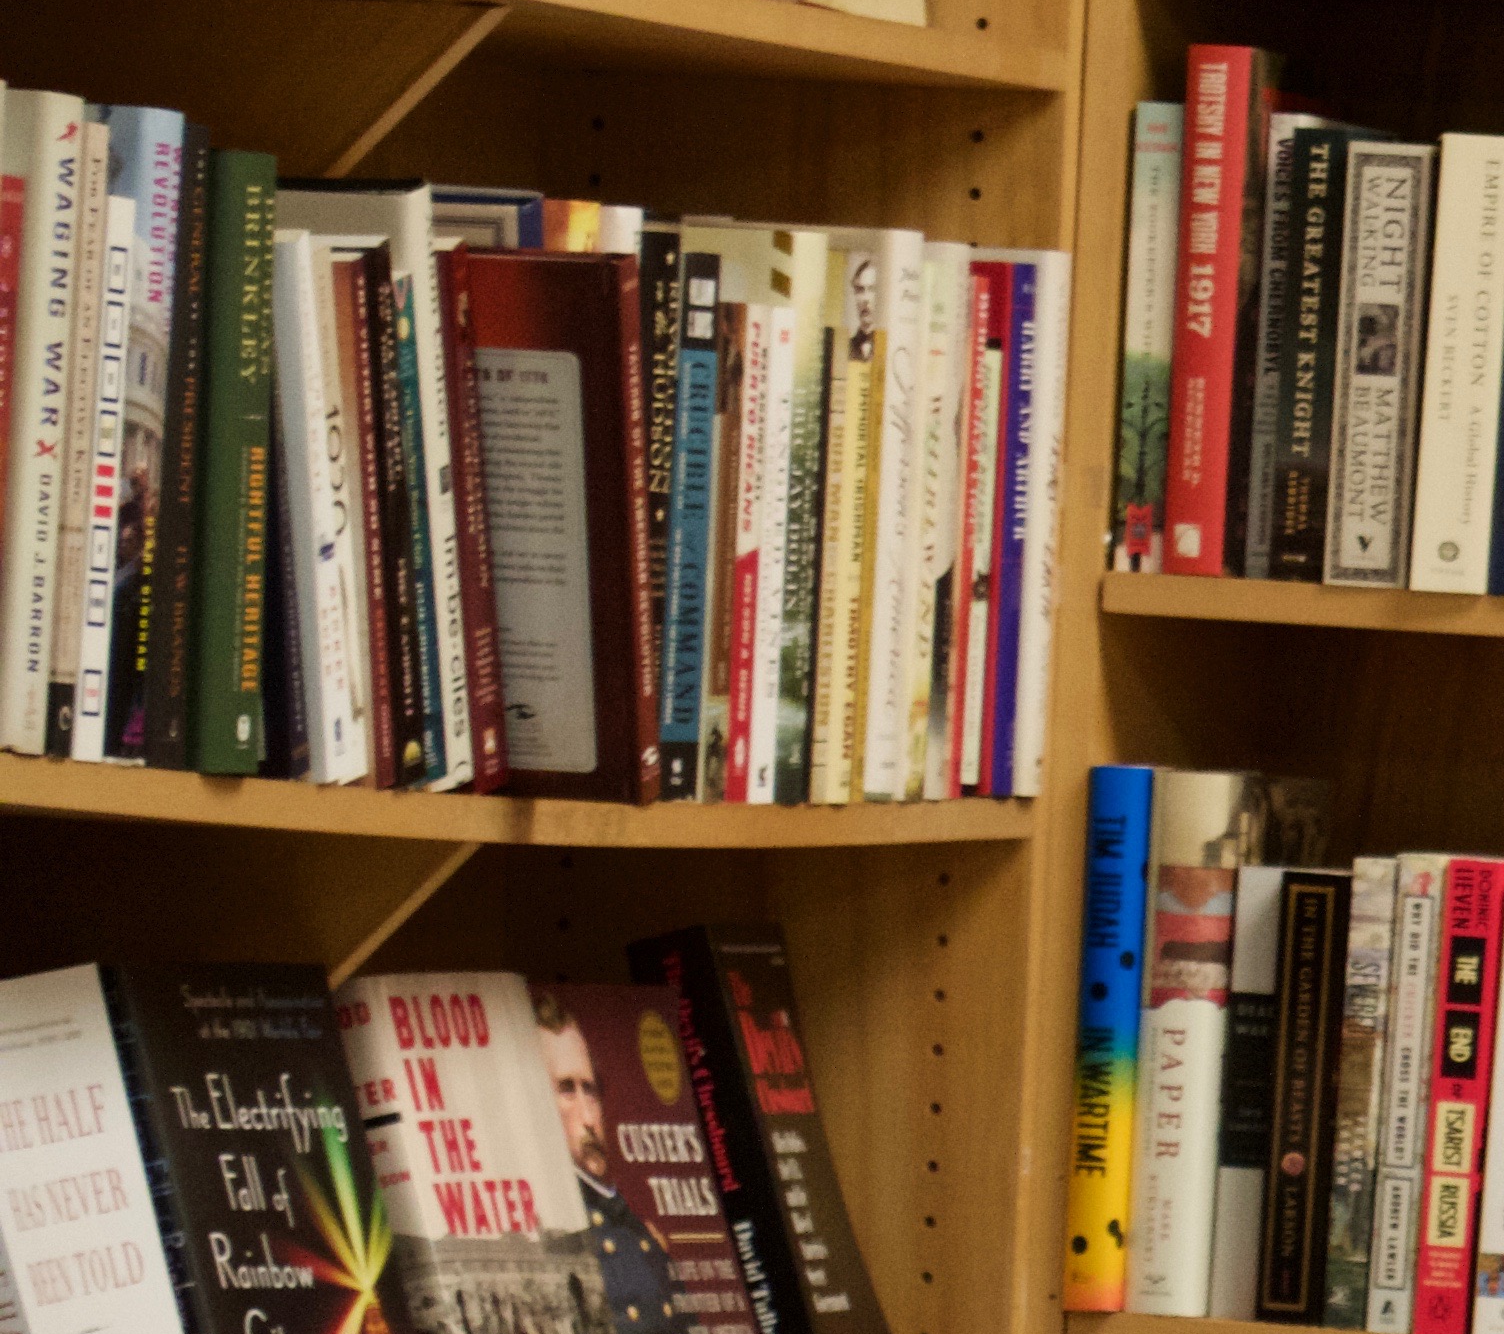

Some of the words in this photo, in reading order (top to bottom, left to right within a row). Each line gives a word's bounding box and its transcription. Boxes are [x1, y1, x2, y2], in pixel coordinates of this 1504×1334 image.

[46, 154, 77, 322] WAGING
[40, 342, 65, 428] WAR
[387, 994, 489, 1048] BLOOD
[170, 1085, 210, 1128] The
[206, 1074, 348, 1152] Electrifying
[405, 1057, 442, 1113] IN
[418, 1118, 484, 1173] THE
[220, 1154, 264, 1211] Fall
[271, 1166, 296, 1225] of
[433, 1180, 540, 1236] WATER
[646, 1176, 715, 1217] TRIALS
[208, 1232, 315, 1290] Rainbow
